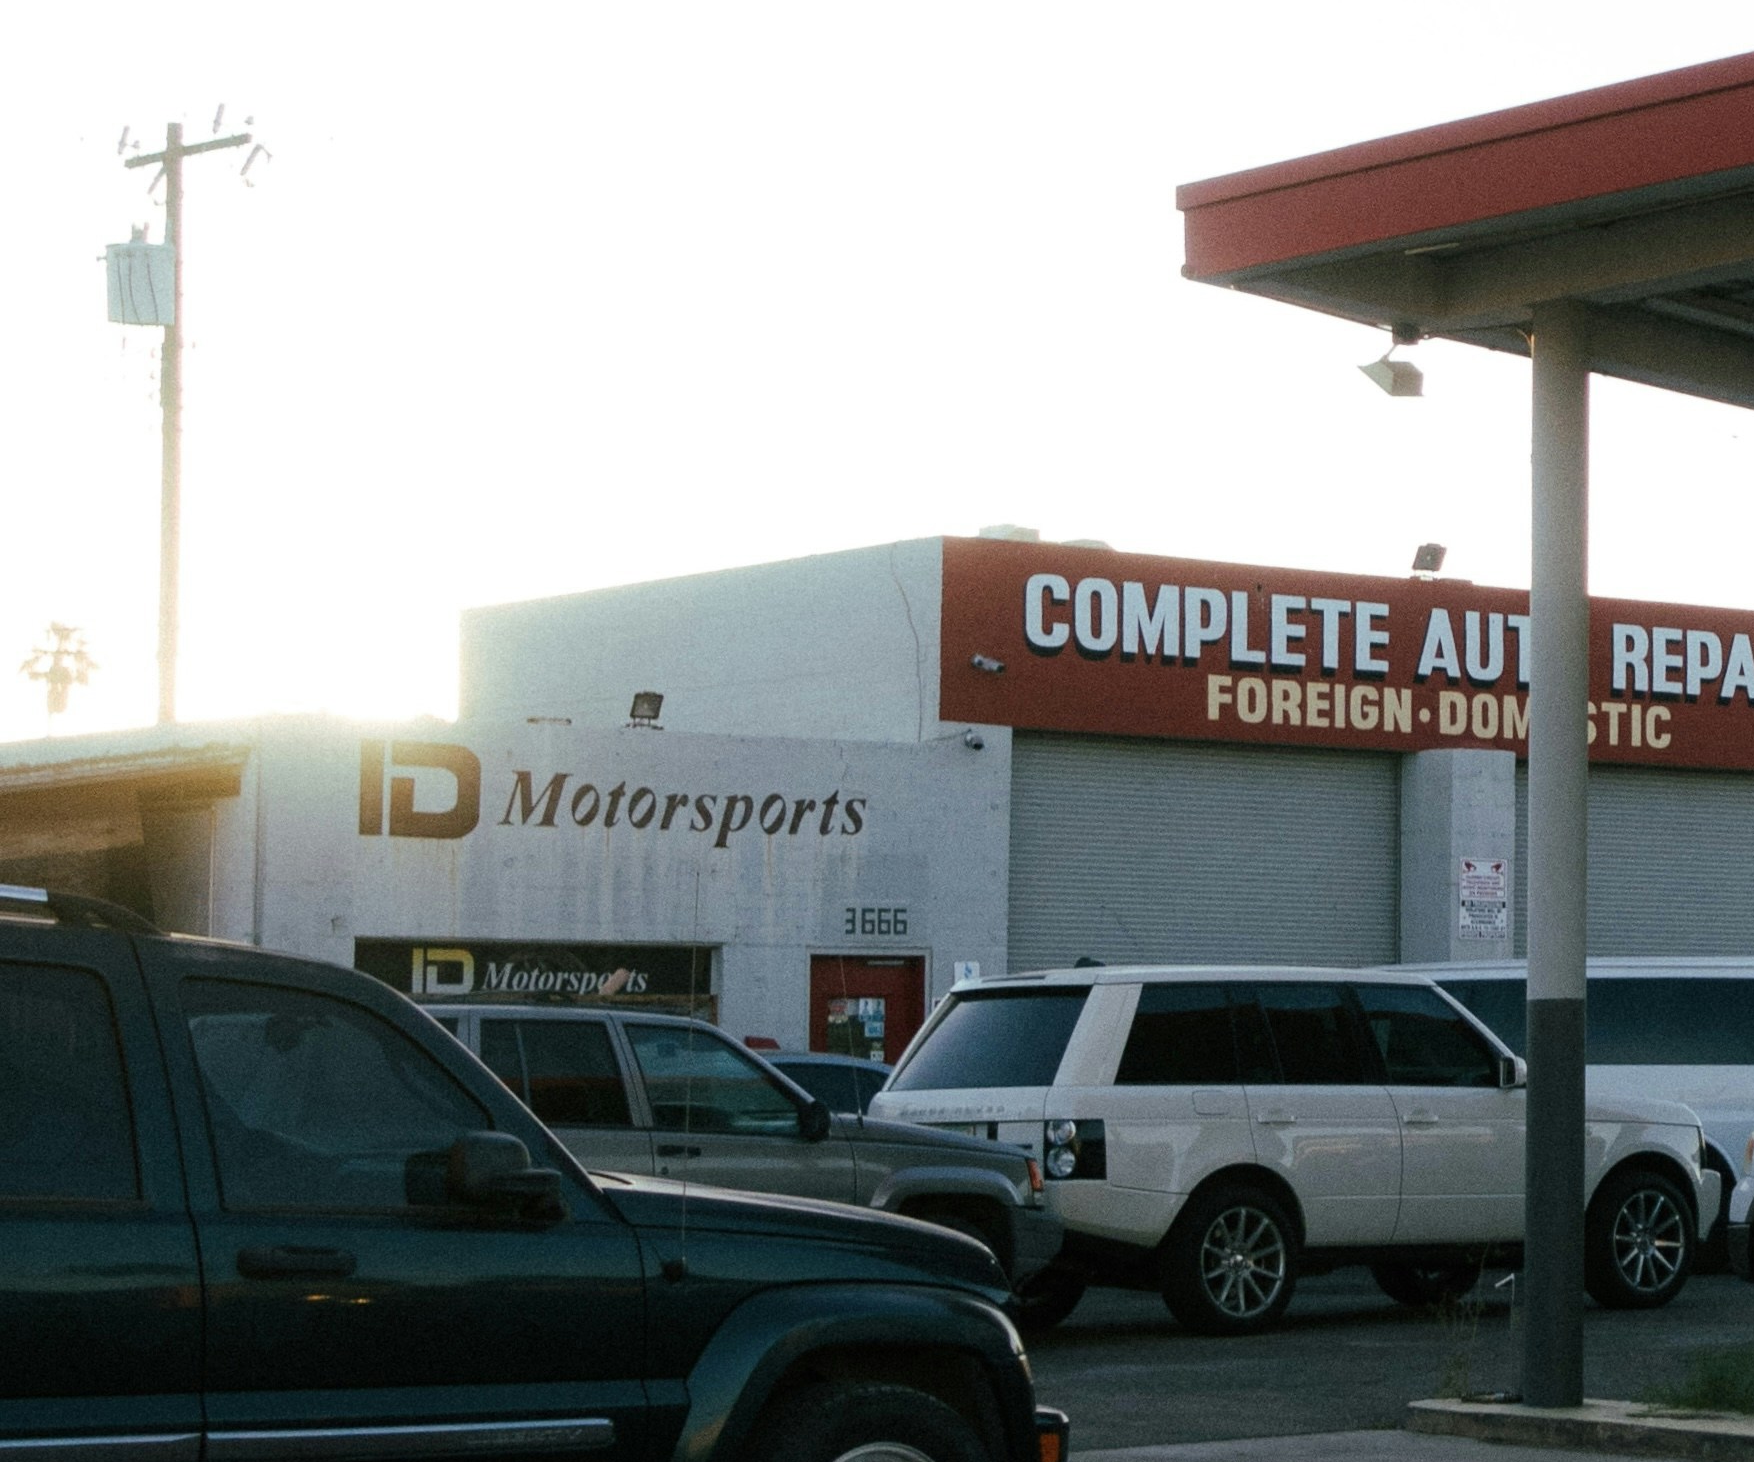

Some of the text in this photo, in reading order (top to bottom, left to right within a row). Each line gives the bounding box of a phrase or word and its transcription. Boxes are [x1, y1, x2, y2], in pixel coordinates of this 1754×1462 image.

[1024, 573, 1390, 677] COMPLETE
[1416, 608, 1531, 686] AUT
[1207, 674, 1672, 749] FOREIGN DOMTIC
[497, 770, 868, 848] Motorsports
[845, 907, 907, 935] 3666
[482, 961, 649, 995] Motorspots
